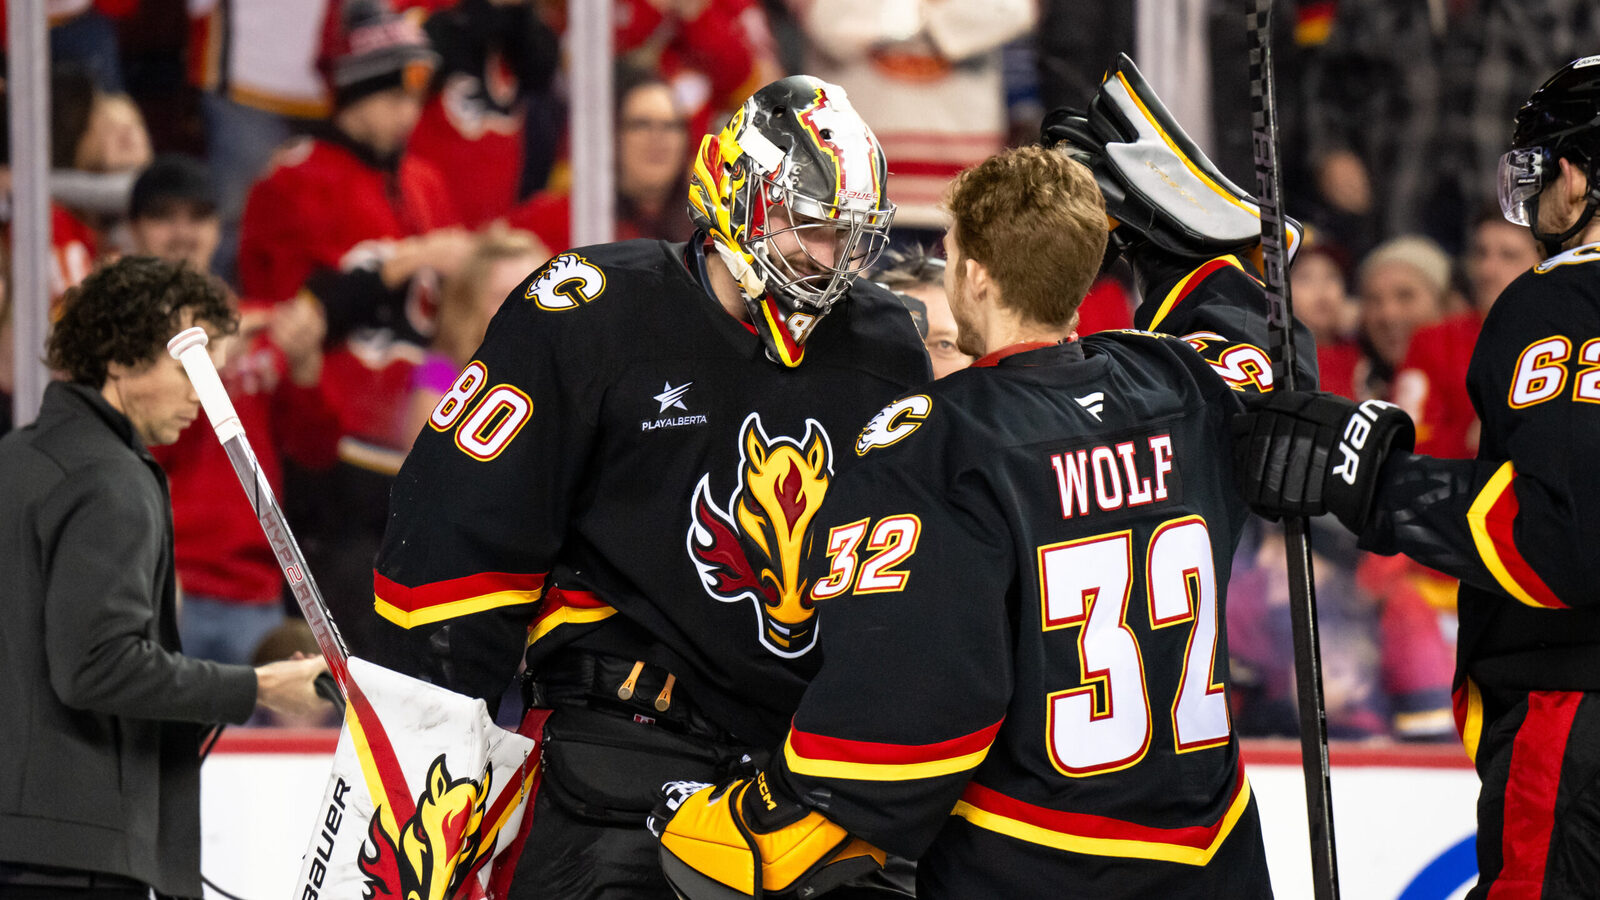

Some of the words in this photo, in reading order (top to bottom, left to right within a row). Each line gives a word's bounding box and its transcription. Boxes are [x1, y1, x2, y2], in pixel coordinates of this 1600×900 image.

[428, 360, 534, 462] 80
[641, 415, 707, 431] PLAYALBERTA
[1332, 399, 1400, 486] UER
[1051, 434, 1173, 520] WOLF
[810, 513, 922, 600] 32
[1037, 514, 1230, 778] 32
[757, 771, 778, 811] CCM
